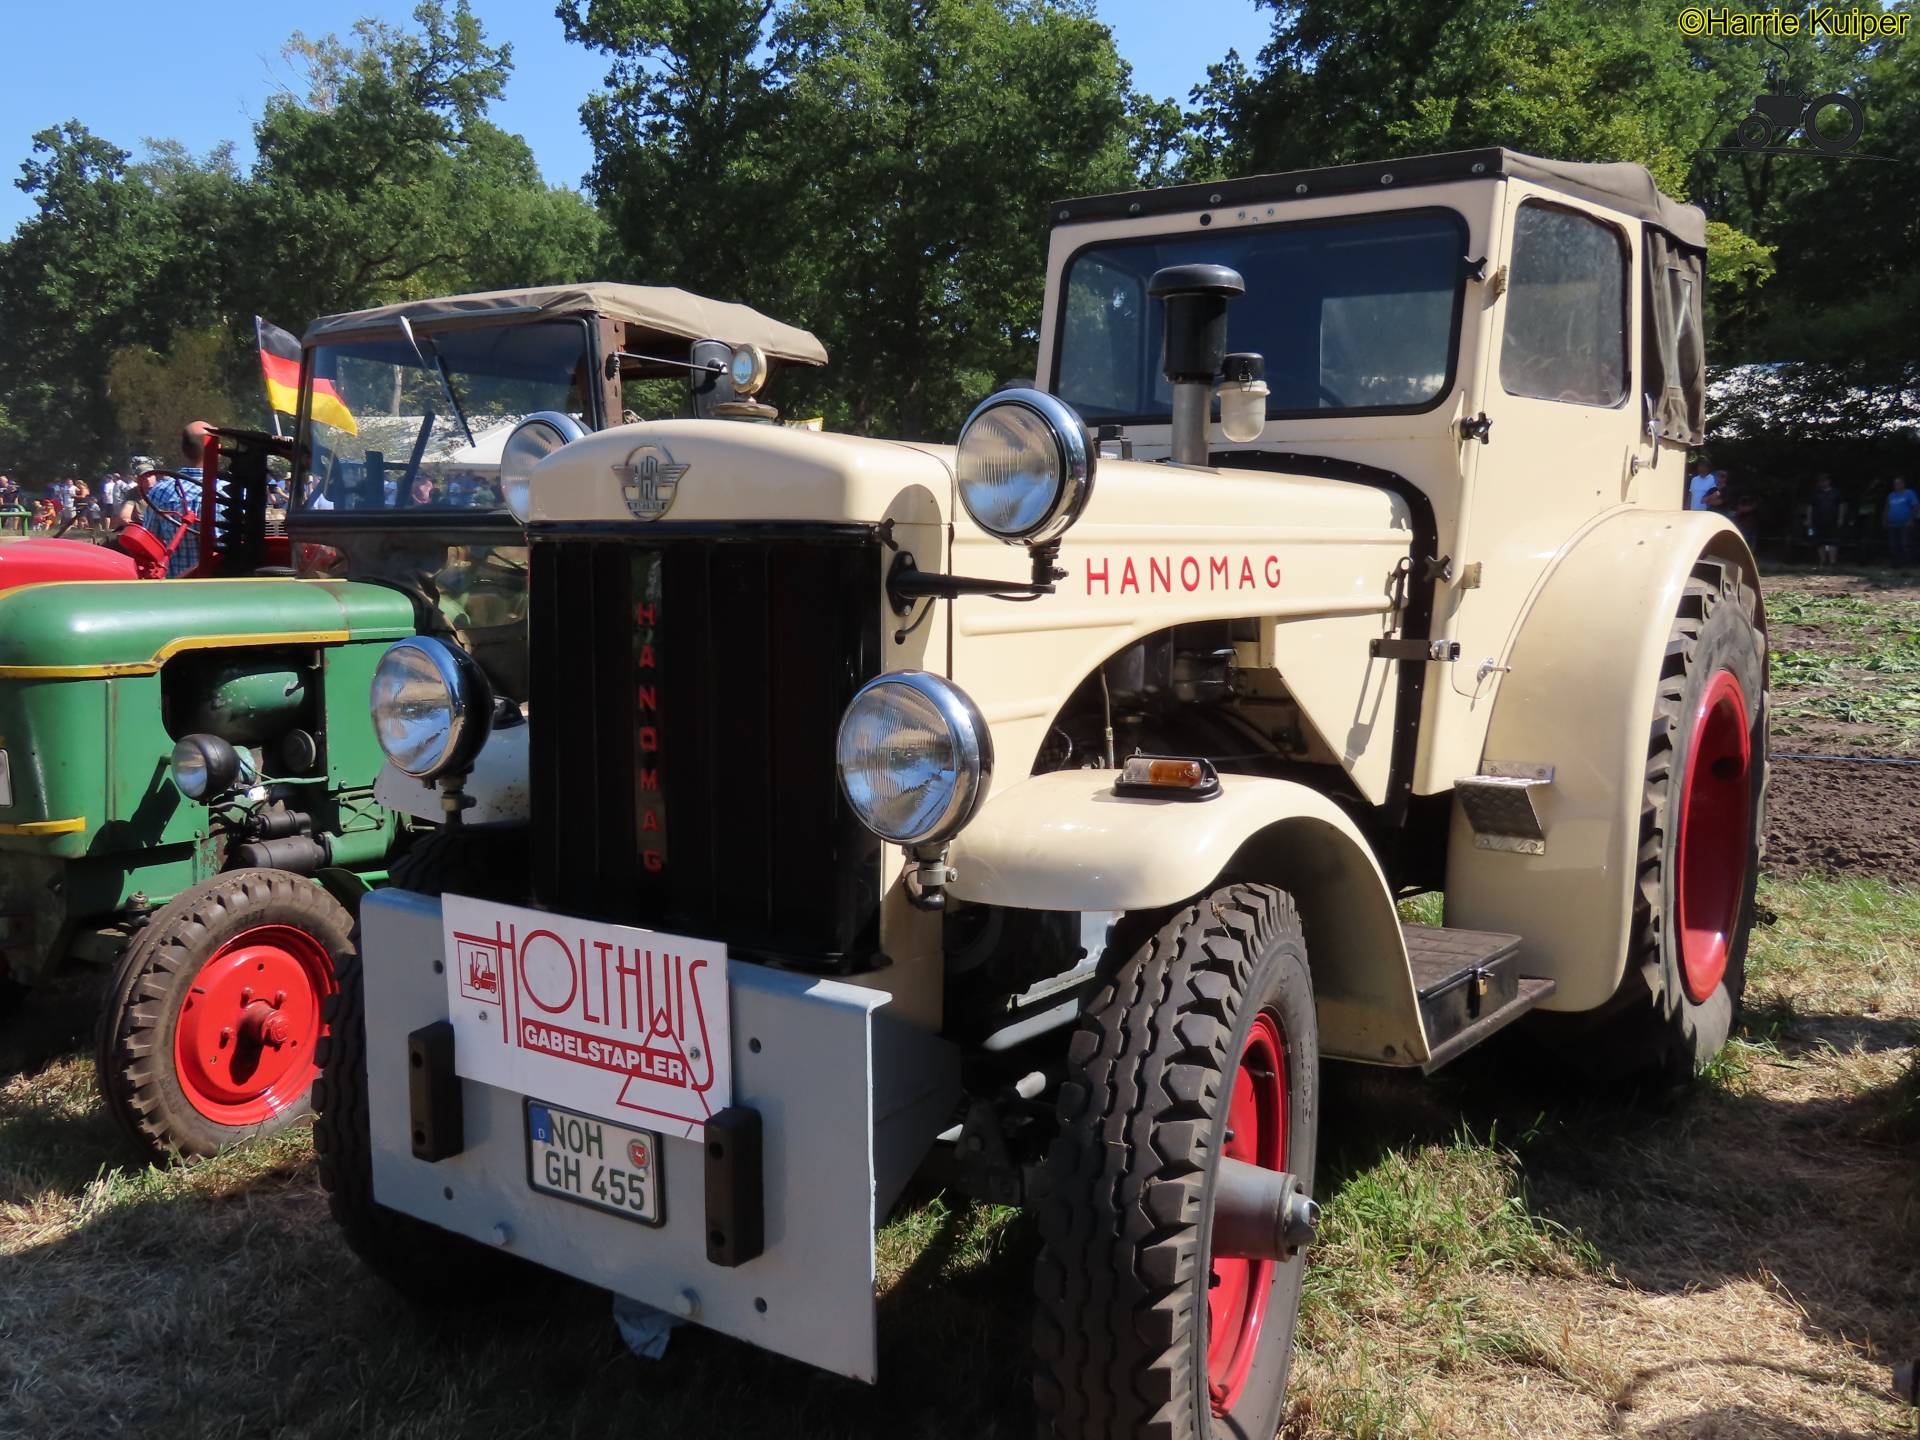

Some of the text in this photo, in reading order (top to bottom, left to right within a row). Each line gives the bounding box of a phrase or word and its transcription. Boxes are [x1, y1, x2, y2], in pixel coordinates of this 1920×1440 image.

[1087, 555, 1281, 595] HANOMAG
[637, 601, 663, 872] HANOMAG
[453, 921, 714, 1091] HOLTHUIS
[524, 1025, 684, 1081] GABELSTAPLER
[550, 1115, 603, 1160] NOH
[545, 1151, 645, 1211] GH 455
